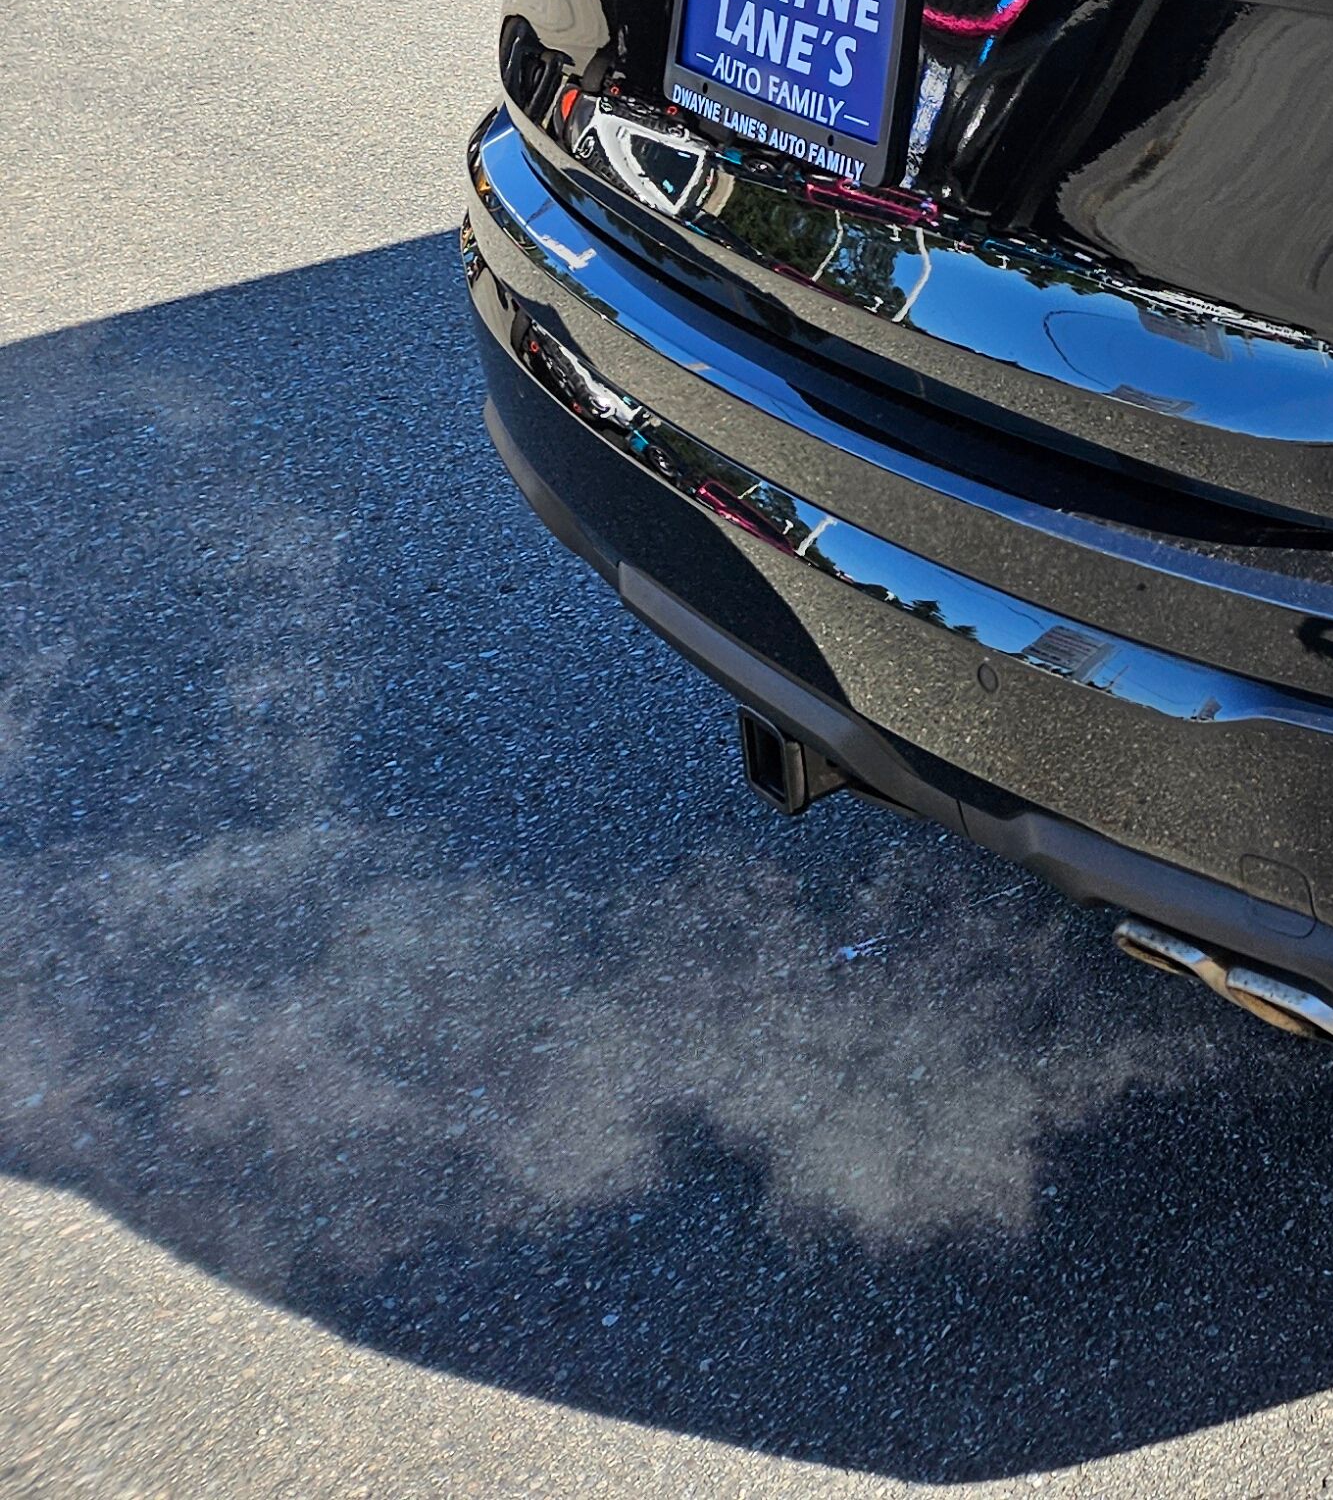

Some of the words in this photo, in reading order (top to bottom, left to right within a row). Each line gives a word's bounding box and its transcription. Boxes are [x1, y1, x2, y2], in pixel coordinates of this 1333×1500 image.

[712, 53, 761, 95] AUTO
[768, 75, 845, 126] FAMILY
[672, 84, 721, 122] DWAYNE
[724, 107, 768, 143] LANE'S
[769, 128, 806, 159] AUTO
[808, 143, 865, 181] FAMILY
